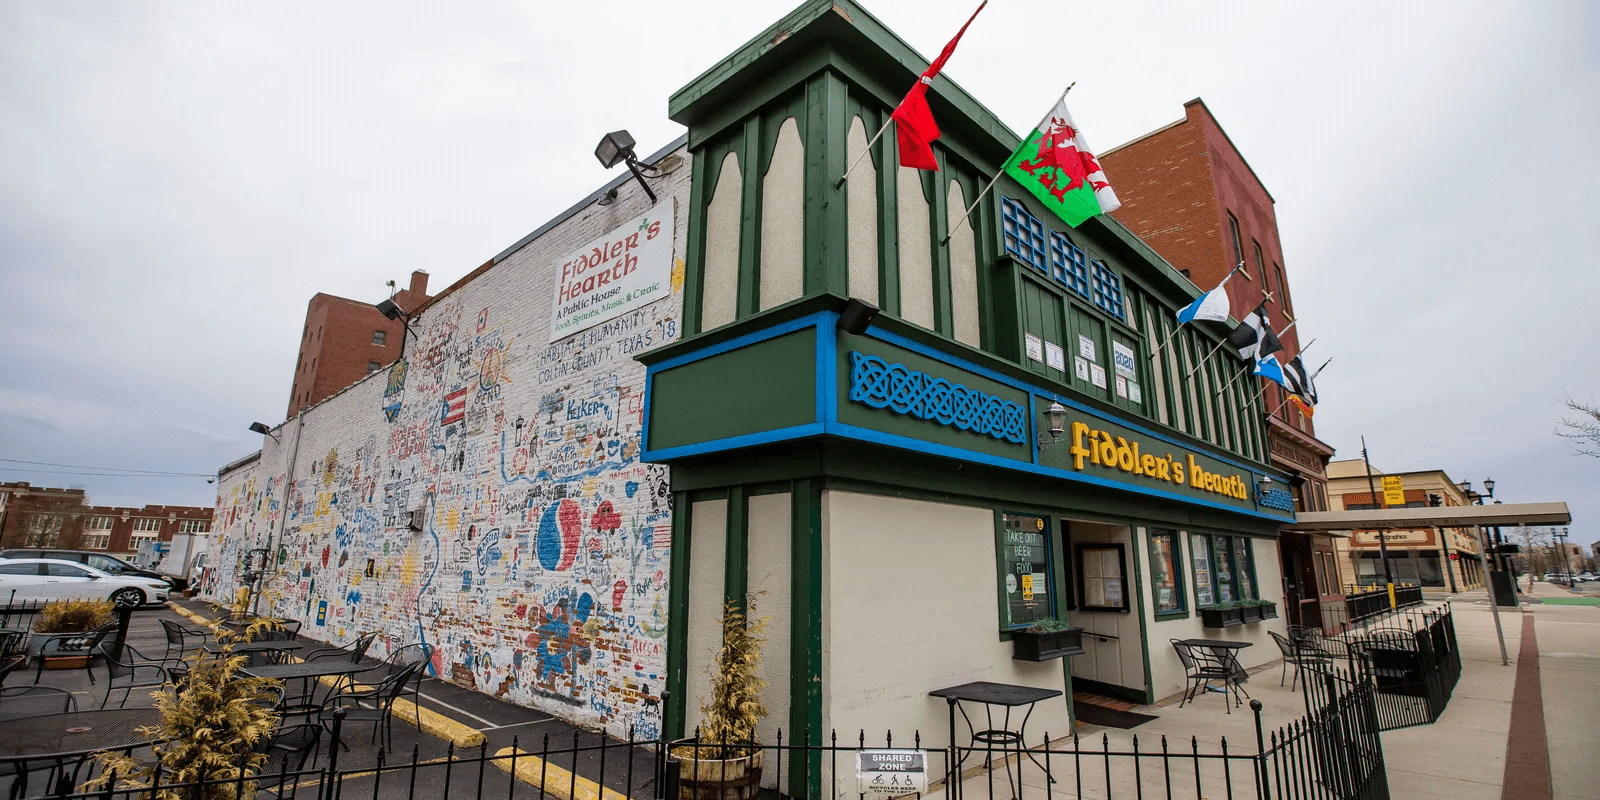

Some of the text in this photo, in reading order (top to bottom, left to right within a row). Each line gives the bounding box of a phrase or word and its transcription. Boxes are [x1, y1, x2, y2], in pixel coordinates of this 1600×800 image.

[561, 220, 661, 284] Fiddler's
[558, 253, 639, 305] Hearth
[554, 319, 572, 332] Food,
[572, 308, 601, 326] Spirits,
[601, 297, 625, 313] Music
[633, 282, 660, 299] Craic
[556, 286, 621, 320] A Public House
[540, 311, 646, 366] HABITAT 4 HUMANITY
[617, 329, 653, 356] TEXAS
[474, 384, 500, 405] BEND
[1186, 453, 1248, 500] hearth
[1006, 530, 1024, 543] TAKE
[1014, 545, 1032, 557] BEER
[1016, 562, 1032, 574] FOOD
[872, 754, 912, 762] SHARED
[878, 763, 906, 771] ZONE
